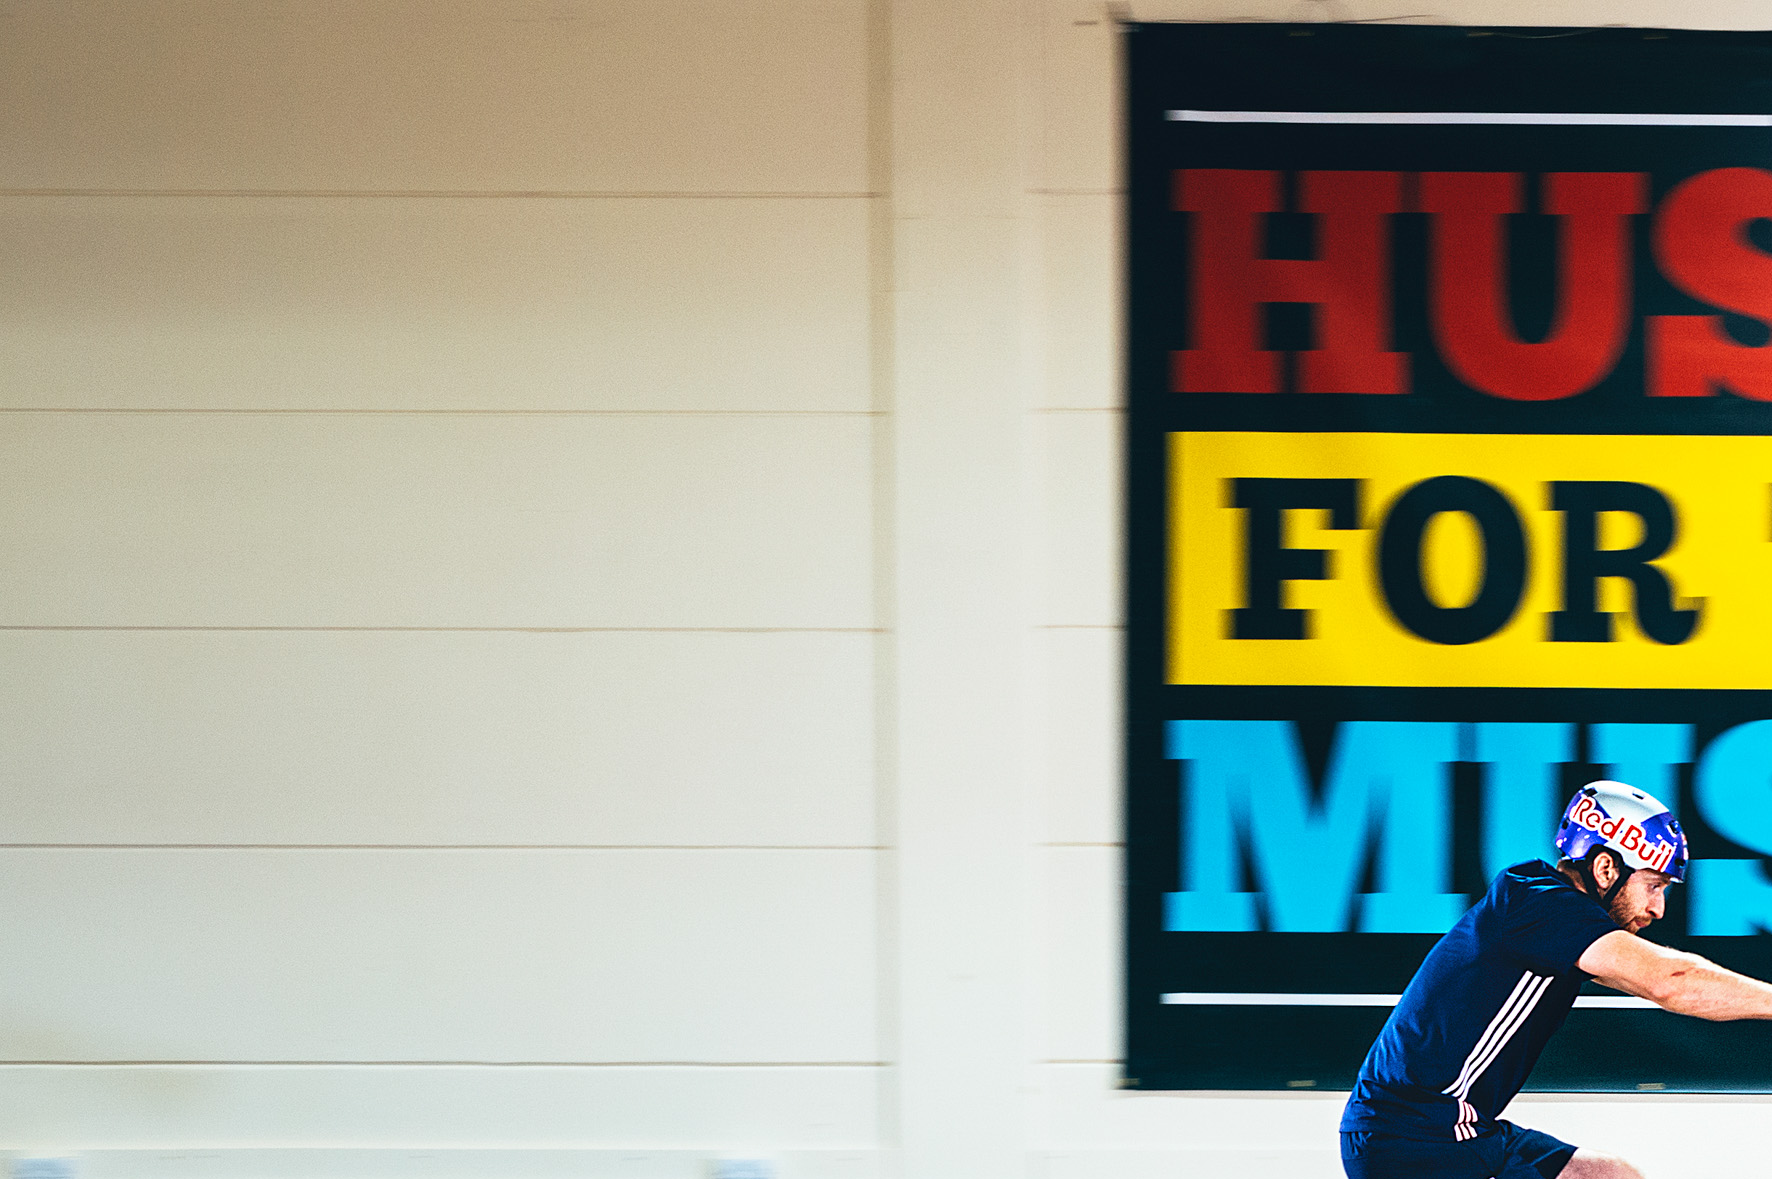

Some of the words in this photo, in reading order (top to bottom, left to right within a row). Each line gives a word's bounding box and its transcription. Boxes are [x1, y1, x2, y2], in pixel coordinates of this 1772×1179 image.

[1219, 473, 1707, 646] FOR
[1572, 798, 1625, 840] Red
[1619, 824, 1672, 872] Bull
